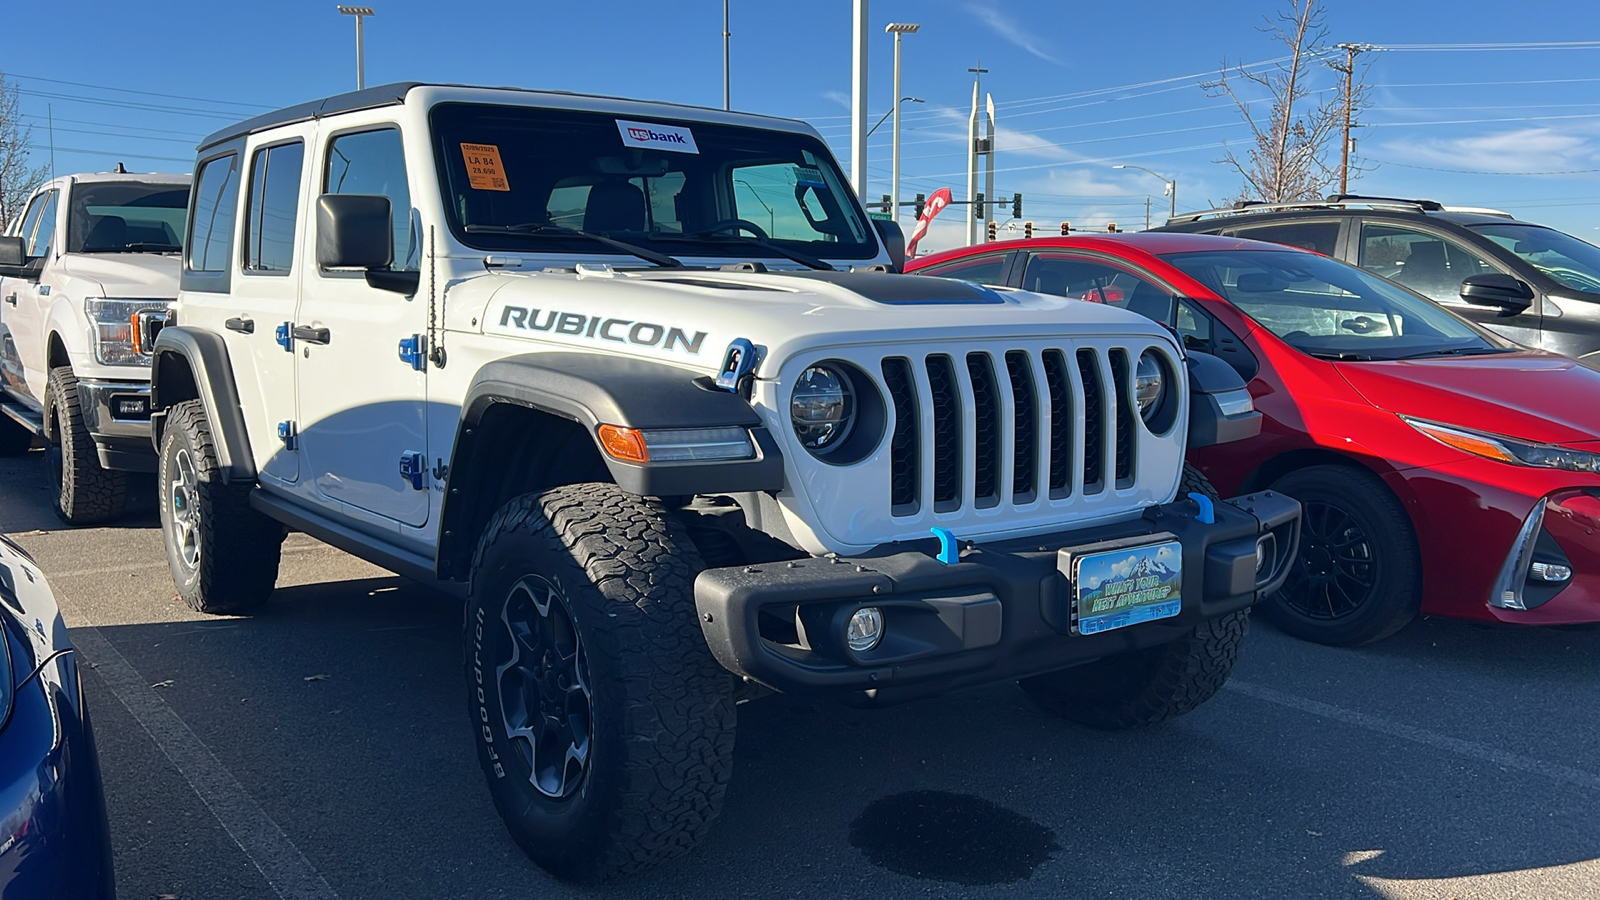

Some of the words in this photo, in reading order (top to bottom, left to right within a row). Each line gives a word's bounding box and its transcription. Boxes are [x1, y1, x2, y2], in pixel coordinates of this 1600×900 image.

[462, 144, 495, 152] 12/09/2025
[468, 156, 481, 165] LA
[482, 157, 494, 166] 84
[499, 304, 709, 355] RUBICON
[1105, 579, 1134, 596] WHAT'S
[1136, 575, 1159, 590] YOUR
[1092, 596, 1117, 612] NEXT
[1116, 586, 1171, 608] ADVENTURE?
[473, 607, 506, 779] BFGoodrich
